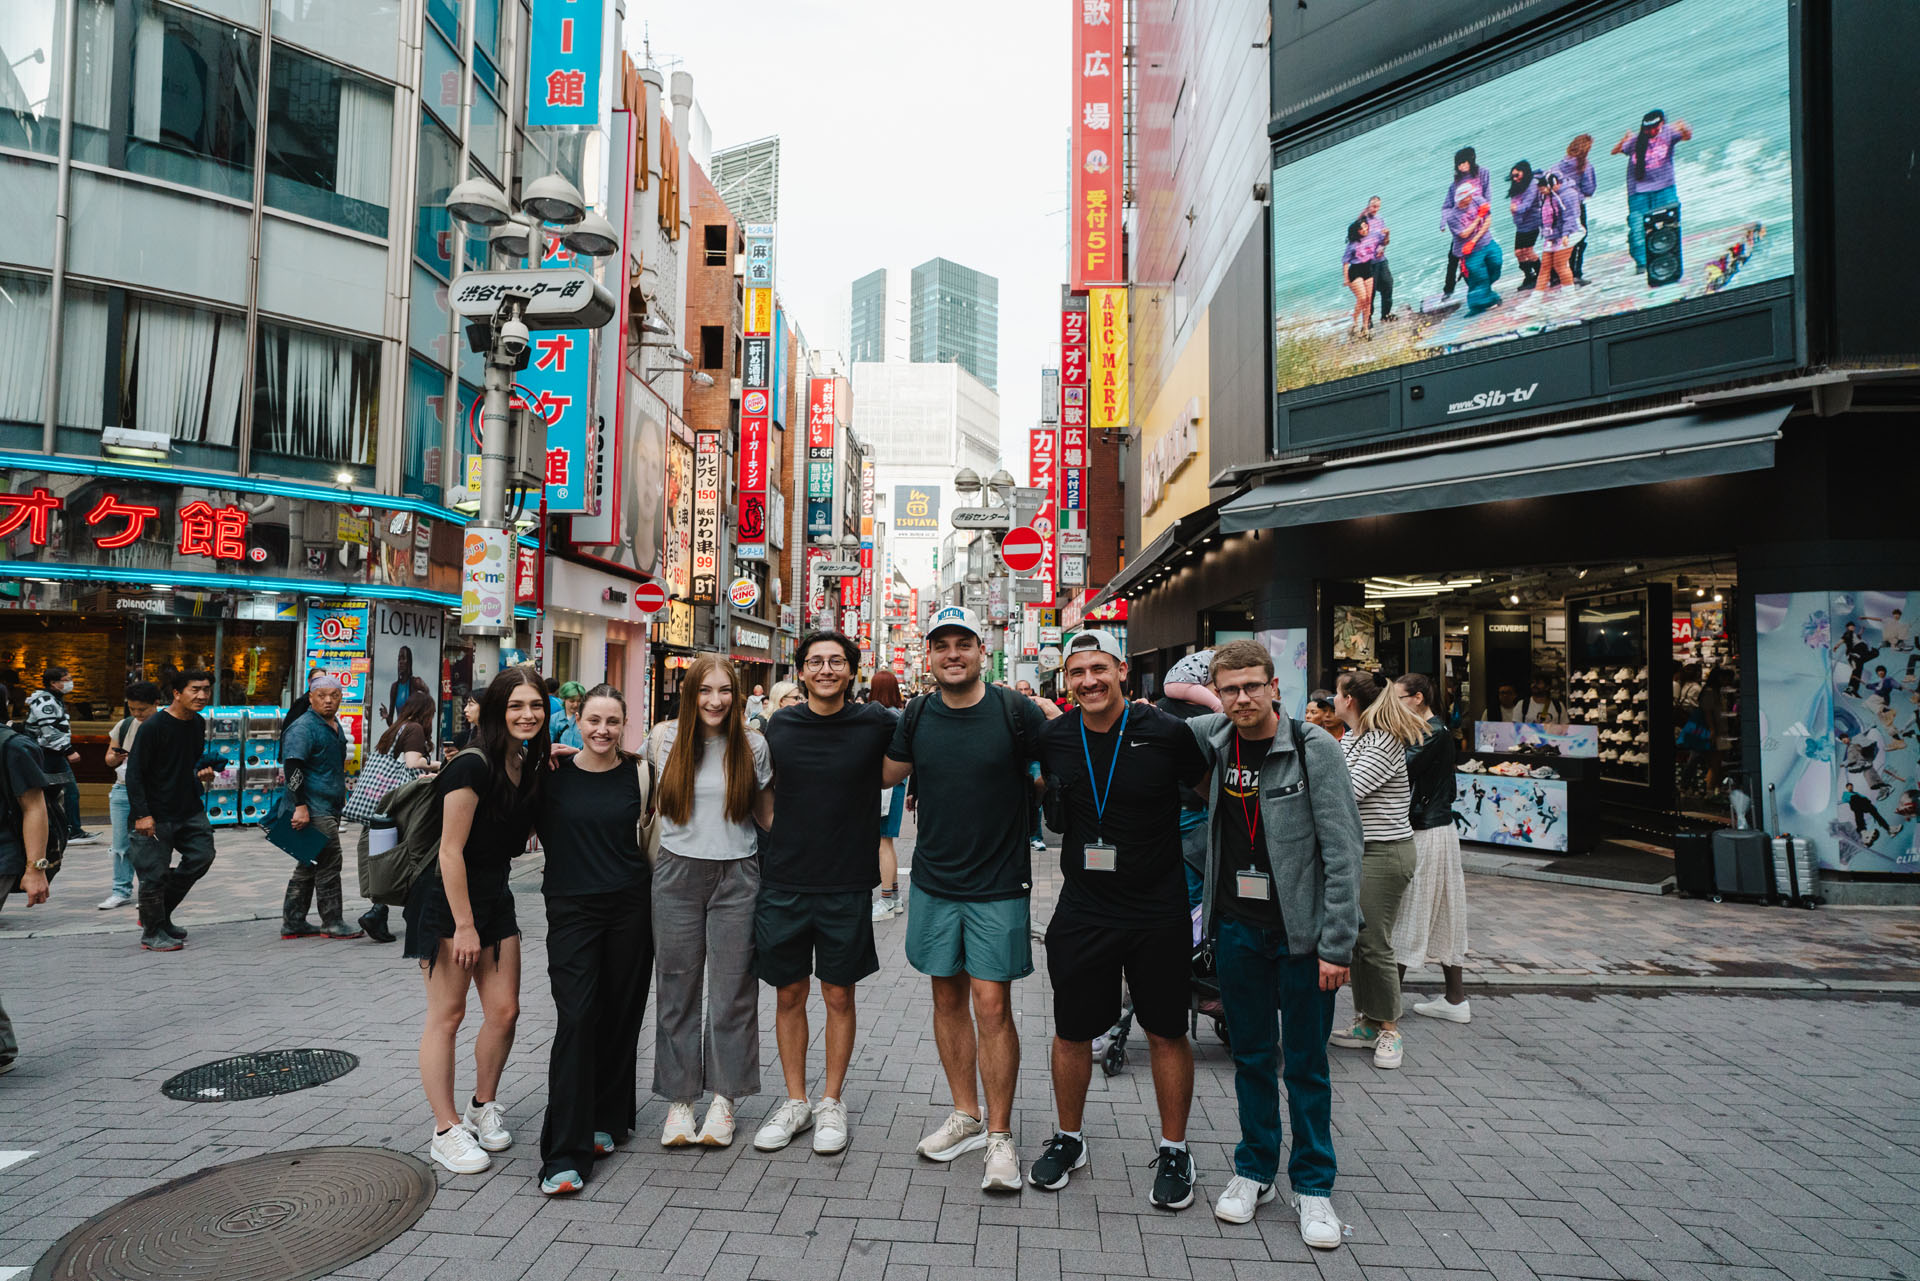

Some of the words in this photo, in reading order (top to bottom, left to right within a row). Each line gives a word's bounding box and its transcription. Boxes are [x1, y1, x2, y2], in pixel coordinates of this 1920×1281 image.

[1087, 190, 1108, 271] 受付5F
[752, 244, 767, 279] 麻雀
[1066, 313, 1083, 382] カラオケ
[811, 404, 823, 444] もんじゃ
[1064, 407, 1083, 466] 歌広場
[749, 421, 759, 488] バーガーキング
[697, 457, 707, 488] サワー
[707, 455, 717, 487] レモン
[810, 464, 821, 493] 無呼吸
[821, 463, 832, 493] いびき
[697, 490, 716, 500] 150
[1067, 469, 1080, 508] 受付2F
[896, 518, 938, 527] TSUTAYA
[696, 556, 713, 568] 99
[731, 583, 755, 595] BURGER
[732, 590, 756, 601] KING
[381, 609, 437, 639] LOEWE
[1489, 624, 1529, 633] CONVERSE
